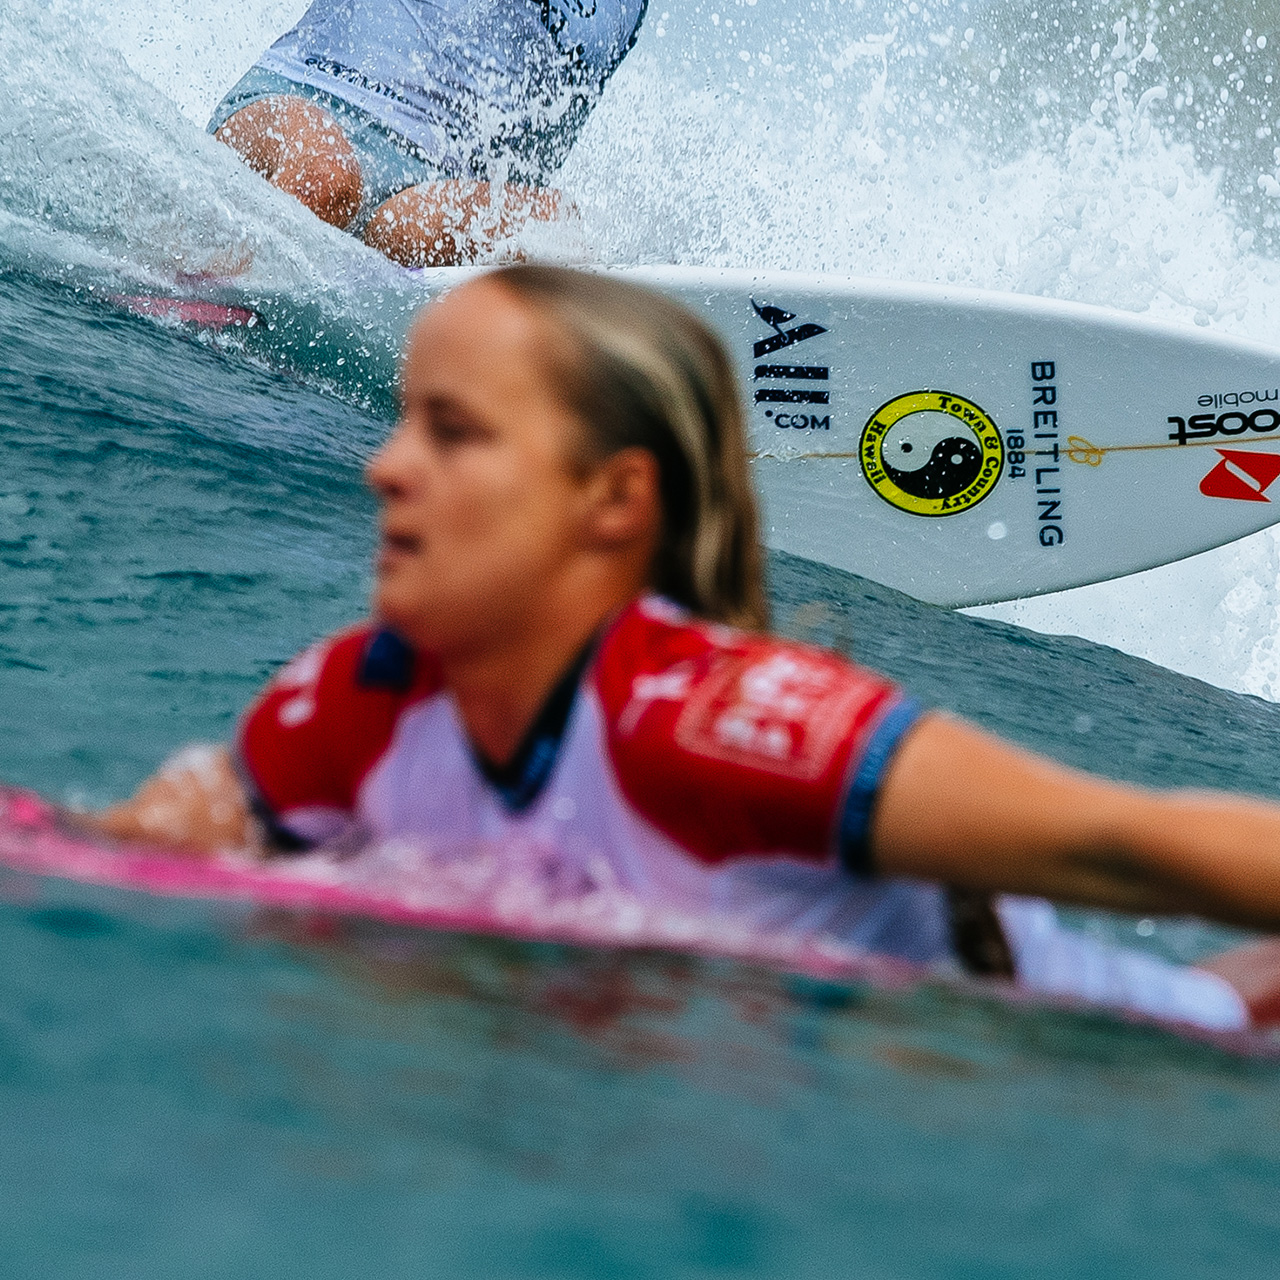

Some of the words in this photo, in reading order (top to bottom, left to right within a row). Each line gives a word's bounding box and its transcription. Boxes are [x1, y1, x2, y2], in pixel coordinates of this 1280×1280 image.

[938, 395, 987, 433] Town
[1197, 389, 1278, 408] mobile
[864, 419, 887, 485] Hawaii
[984, 436, 999, 451] &
[1006, 429, 1026, 479] 1884
[1031, 361, 1064, 547] BREITLING
[940, 456, 999, 511] Country
